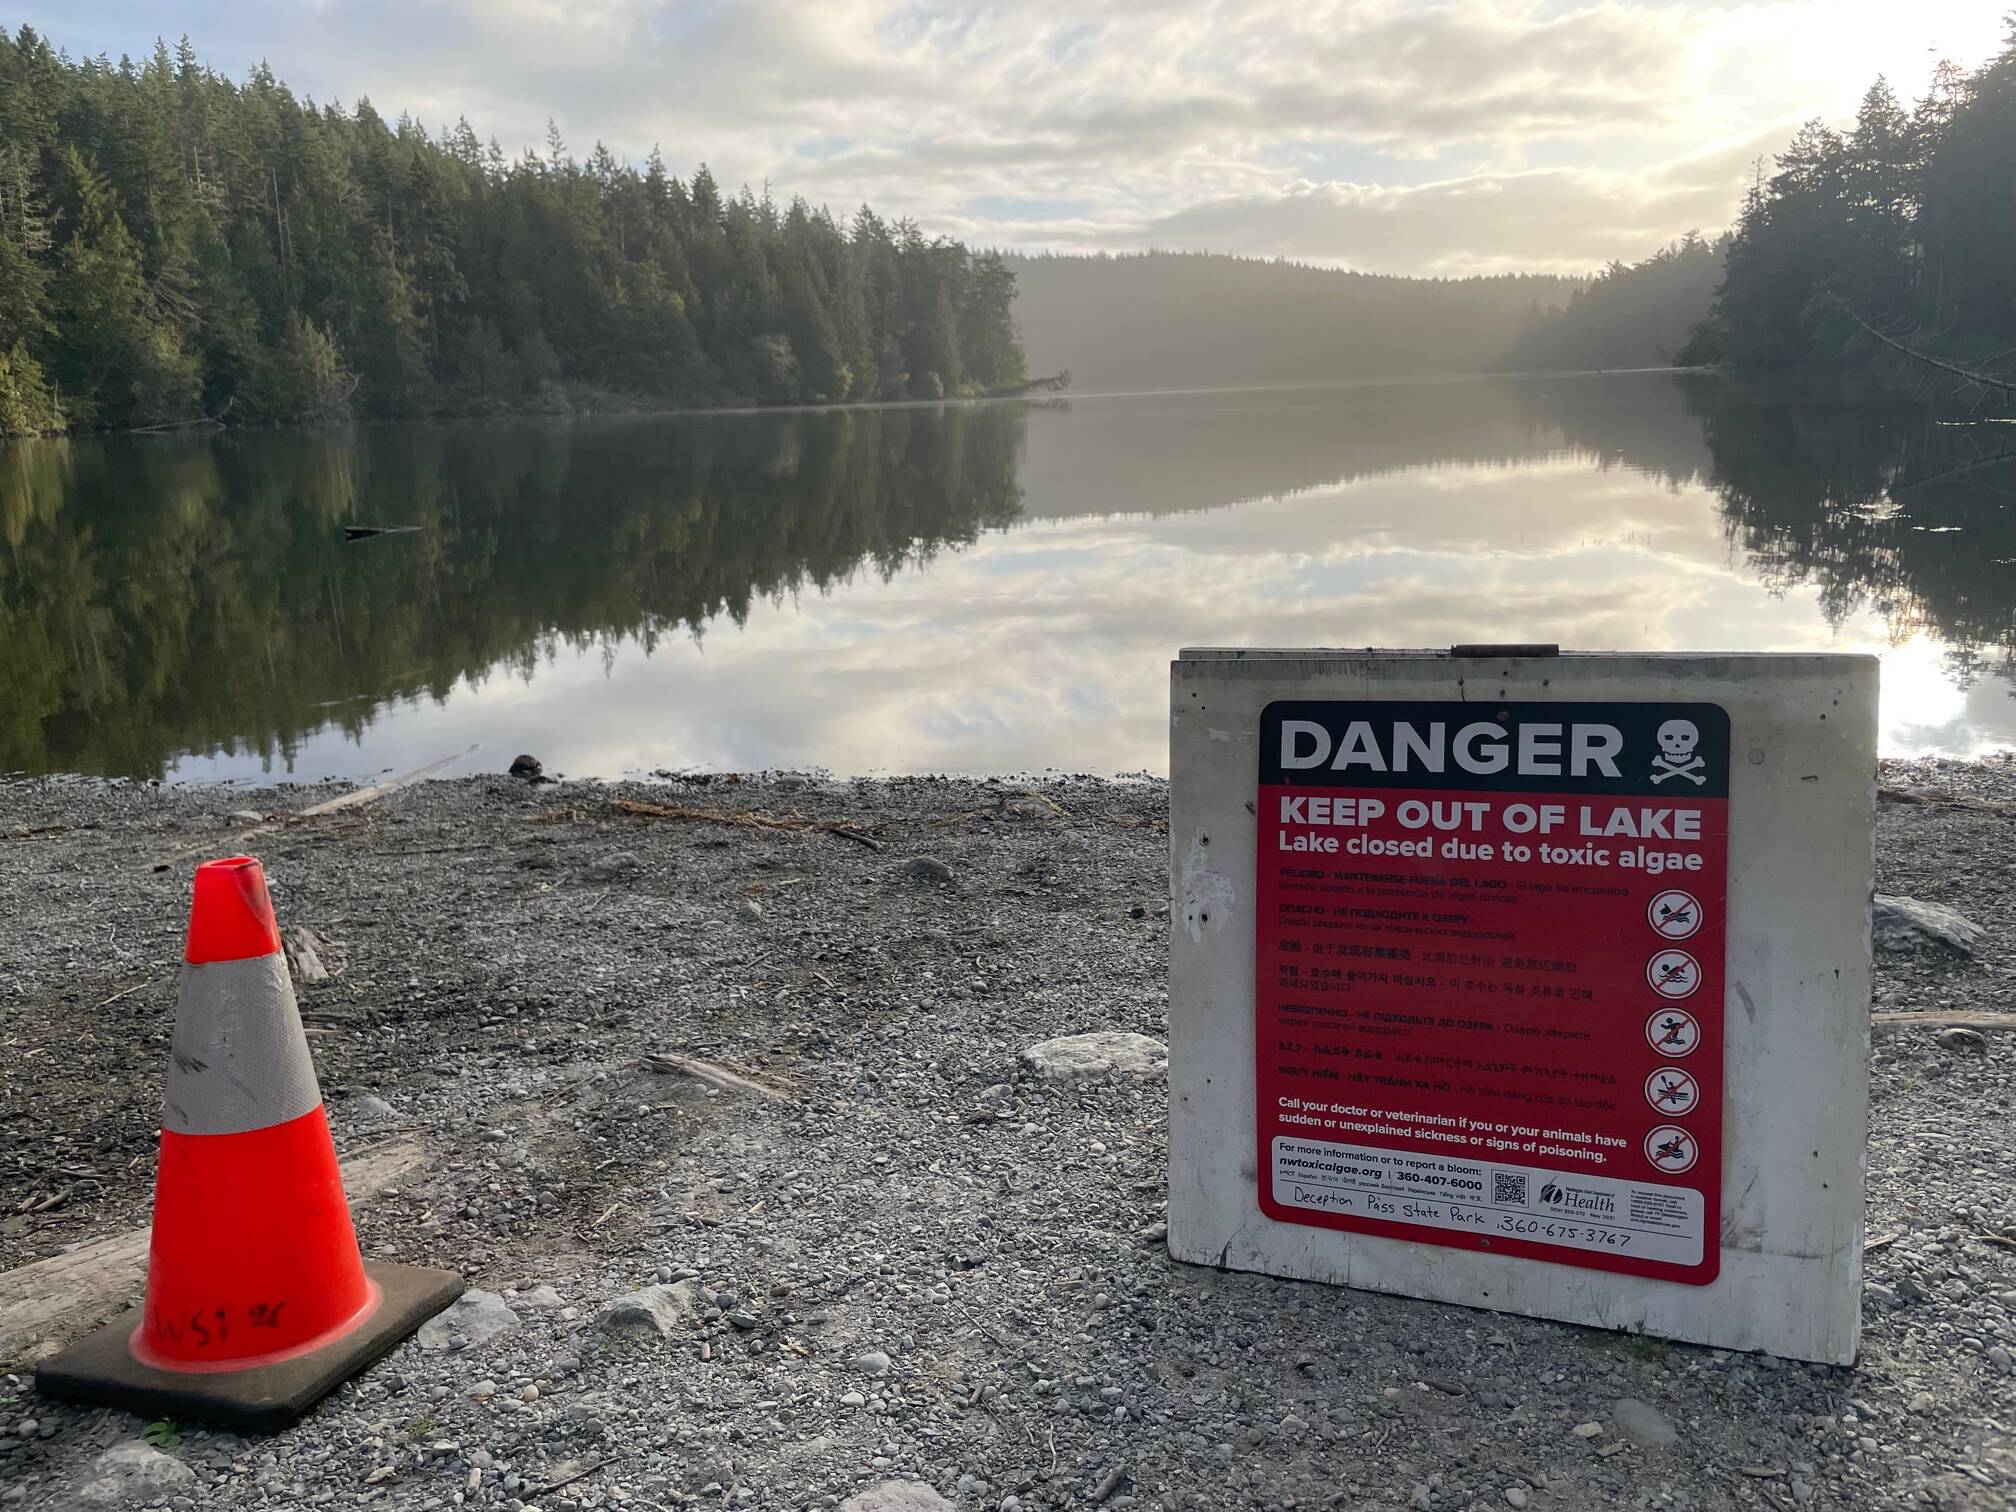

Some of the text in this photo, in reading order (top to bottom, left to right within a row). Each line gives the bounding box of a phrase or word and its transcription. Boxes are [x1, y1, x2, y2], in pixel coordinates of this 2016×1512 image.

[1280, 720, 1624, 778] DANGER
[1280, 796, 1701, 840] KEEP OUT OF LAKE
[1279, 830, 1703, 875] Lake closed due to toxic algae
[1280, 868, 1325, 879] PELIGRO
[1449, 877, 1469, 887] DEL
[1475, 879, 1507, 889] LAGO
[1529, 882, 1553, 894] lago
[1571, 886, 1629, 896] encuentra
[1437, 1017, 1455, 1028] ДО
[1456, 1019, 1494, 1031] ОЗЕРА
[1279, 1096, 1628, 1148] Call your doctor or veterinarian if you or your animals have
[1279, 1113, 1607, 1164] sudden or unexplained sickness or signs of poisoning.
[1279, 1142, 1482, 1177] For more information or to report a bloom:
[1279, 1157, 1483, 1191] nwtoxicalgae.org 360-407-6000
[1294, 1186, 1632, 1247] Deception Pass State Park 360-675-3767
[1564, 1191, 1616, 1213] Health
